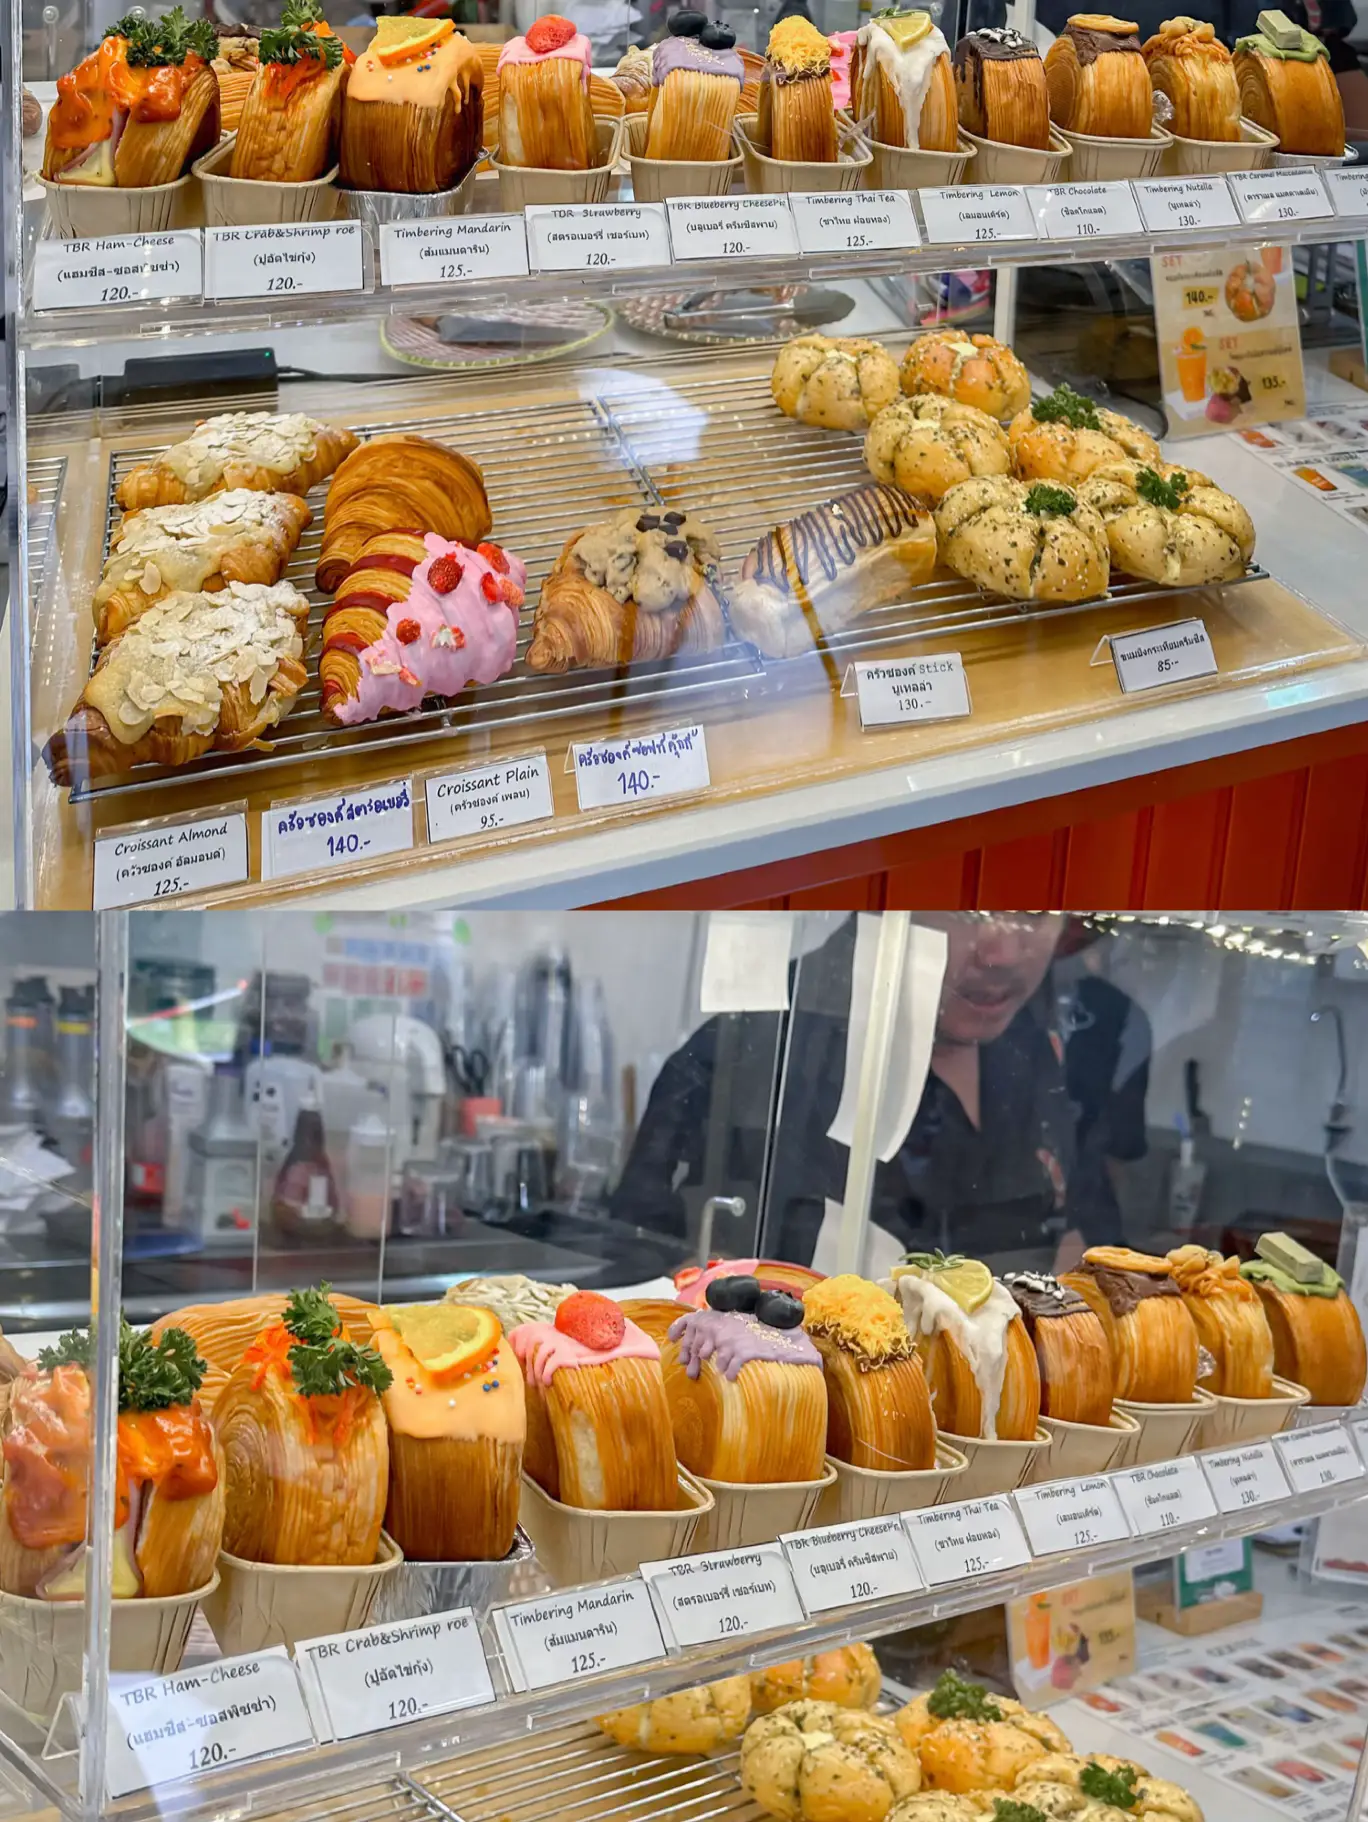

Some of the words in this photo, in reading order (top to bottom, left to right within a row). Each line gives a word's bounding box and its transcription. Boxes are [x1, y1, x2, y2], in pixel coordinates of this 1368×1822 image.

[940, 191, 983, 200] Timbering
[1047, 187, 1066, 196] TBR
[1068, 186, 1106, 195] Chocolate
[1144, 186, 1184, 194] Timbering
[1186, 183, 1213, 191] Nutella
[671, 202, 691, 210] TBR
[695, 201, 740, 210] Blueberry
[805, 196, 852, 205] Timbering
[855, 194, 875, 203] Thai
[879, 194, 895, 202] Tea
[582, 208, 641, 219] Strawberry
[1278, 207, 1299, 217] 130.-
[1178, 214, 1201, 226] 130.-
[213, 231, 240, 241] TBR
[245, 227, 330, 240] Crab&Shrimp
[335, 226, 355, 235] roe
[394, 226, 452, 238] Timbering
[457, 222, 511, 234] Mandarin
[975, 228, 1001, 239] 125.-
[1077, 223, 1100, 235] 110.-
[63, 243, 90, 253] TBR
[96, 235, 174, 251] Ham-Cheese
[723, 242, 751, 253] 120.-
[847, 235, 873, 247] 125.-
[586, 253, 616, 265] 120.-
[440, 264, 472, 278] 125.-
[267, 277, 303, 291] 120.-
[100, 286, 139, 301] 120.-
[919, 661, 953, 674] Stick
[898, 698, 932, 711] 130.-
[437, 774, 500, 798] Croissant
[506, 765, 539, 783] Plain
[617, 770, 660, 795] 140.-
[480, 814, 504, 829] 95.-
[115, 835, 173, 856] Croissant
[178, 822, 227, 843] Almond
[326, 834, 371, 857] 140.-
[154, 877, 189, 897] 125.-
[1034, 1487, 1075, 1500] Timbering
[1080, 1482, 1106, 1492] Lemon
[917, 1511, 960, 1525] Timbering
[963, 1505, 981, 1516] Thai
[983, 1502, 999, 1512] Tea
[1160, 1512, 1180, 1527] 110.-
[790, 1539, 810, 1550] TBR
[812, 1529, 856, 1547] Blueberry
[1074, 1530, 1098, 1545] 125.-
[668, 1563, 695, 1576] TBR
[700, 1553, 762, 1572] Strawberry
[964, 1556, 989, 1573] 125.-
[850, 1582, 878, 1598] 120.-
[510, 1605, 573, 1626] Timbering
[577, 1590, 634, 1612] Mandarin
[719, 1615, 748, 1633] 120.-
[305, 1644, 340, 1659] TBR
[345, 1624, 441, 1653] Crab&Shrimp
[447, 1616, 469, 1632] roe
[571, 1652, 606, 1674] 125.-
[120, 1686, 158, 1706] TBR
[163, 1662, 260, 1696] Ham-Cheese
[388, 1697, 428, 1720] 120.-
[188, 1742, 237, 1770] 120.-
